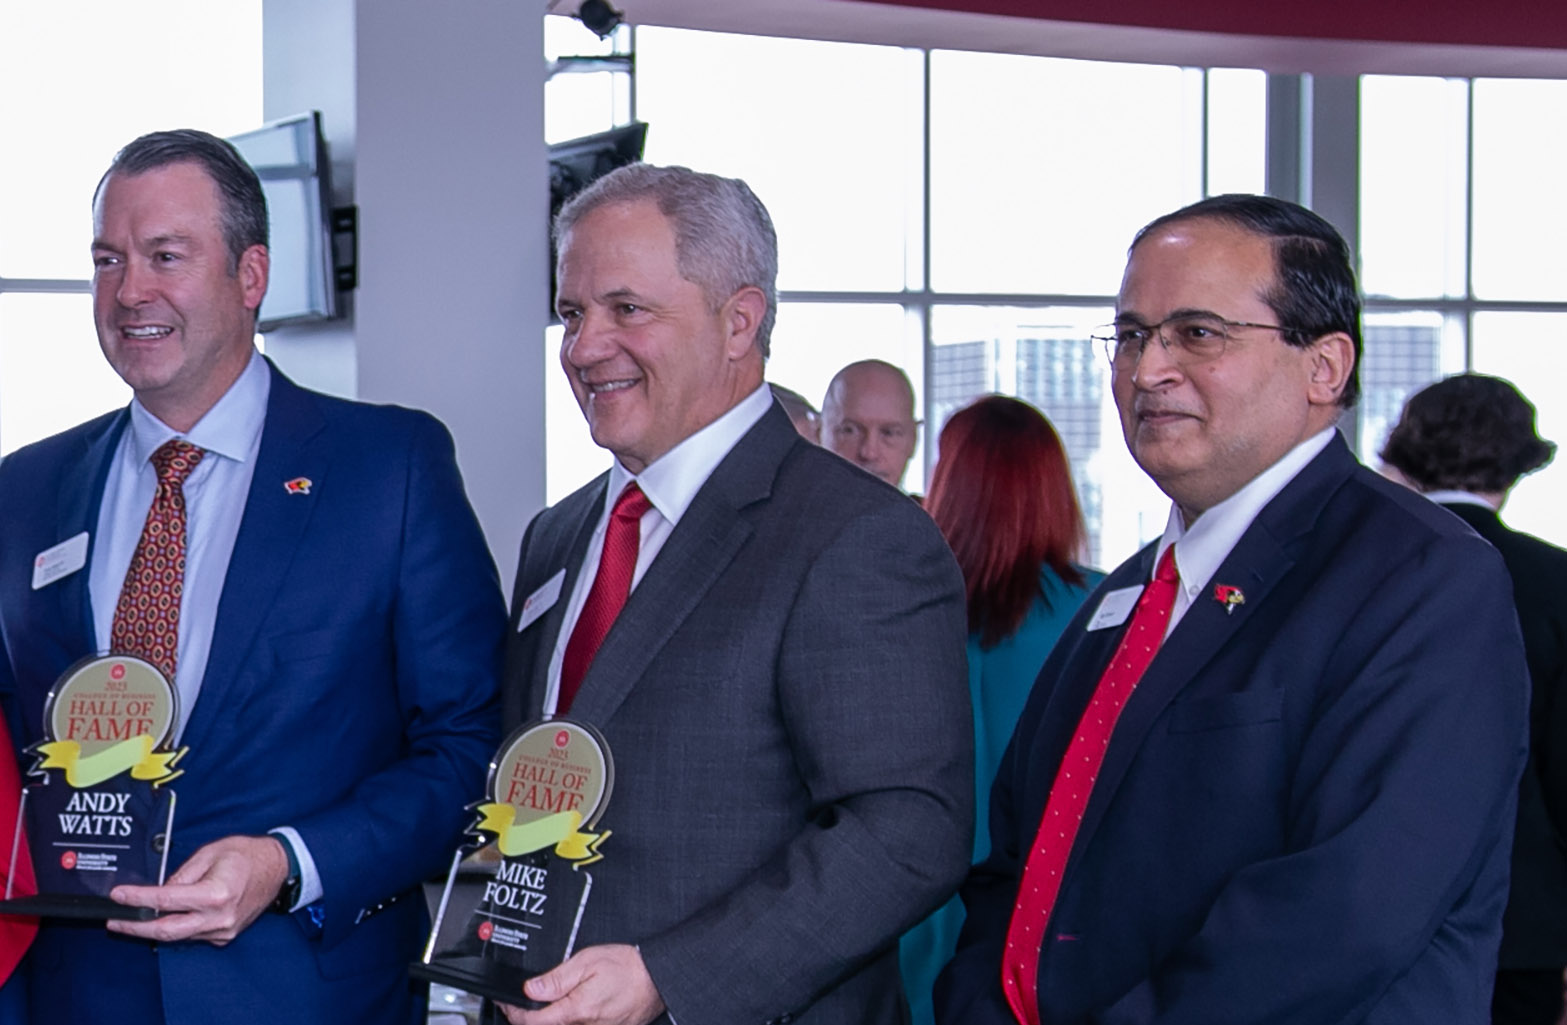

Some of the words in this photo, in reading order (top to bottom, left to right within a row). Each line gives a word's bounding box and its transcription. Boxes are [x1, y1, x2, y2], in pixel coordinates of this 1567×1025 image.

[69, 700, 122, 716] HALL
[126, 700, 154, 717] OF
[66, 717, 154, 741] FAME
[512, 761, 559, 787] HALL
[562, 772, 588, 790] OF
[65, 791, 131, 813] ANDY
[505, 779, 585, 814] FAME
[58, 813, 133, 837] WATTS
[495, 859, 548, 890] MIKE
[483, 881, 548, 915] FOLTZ
